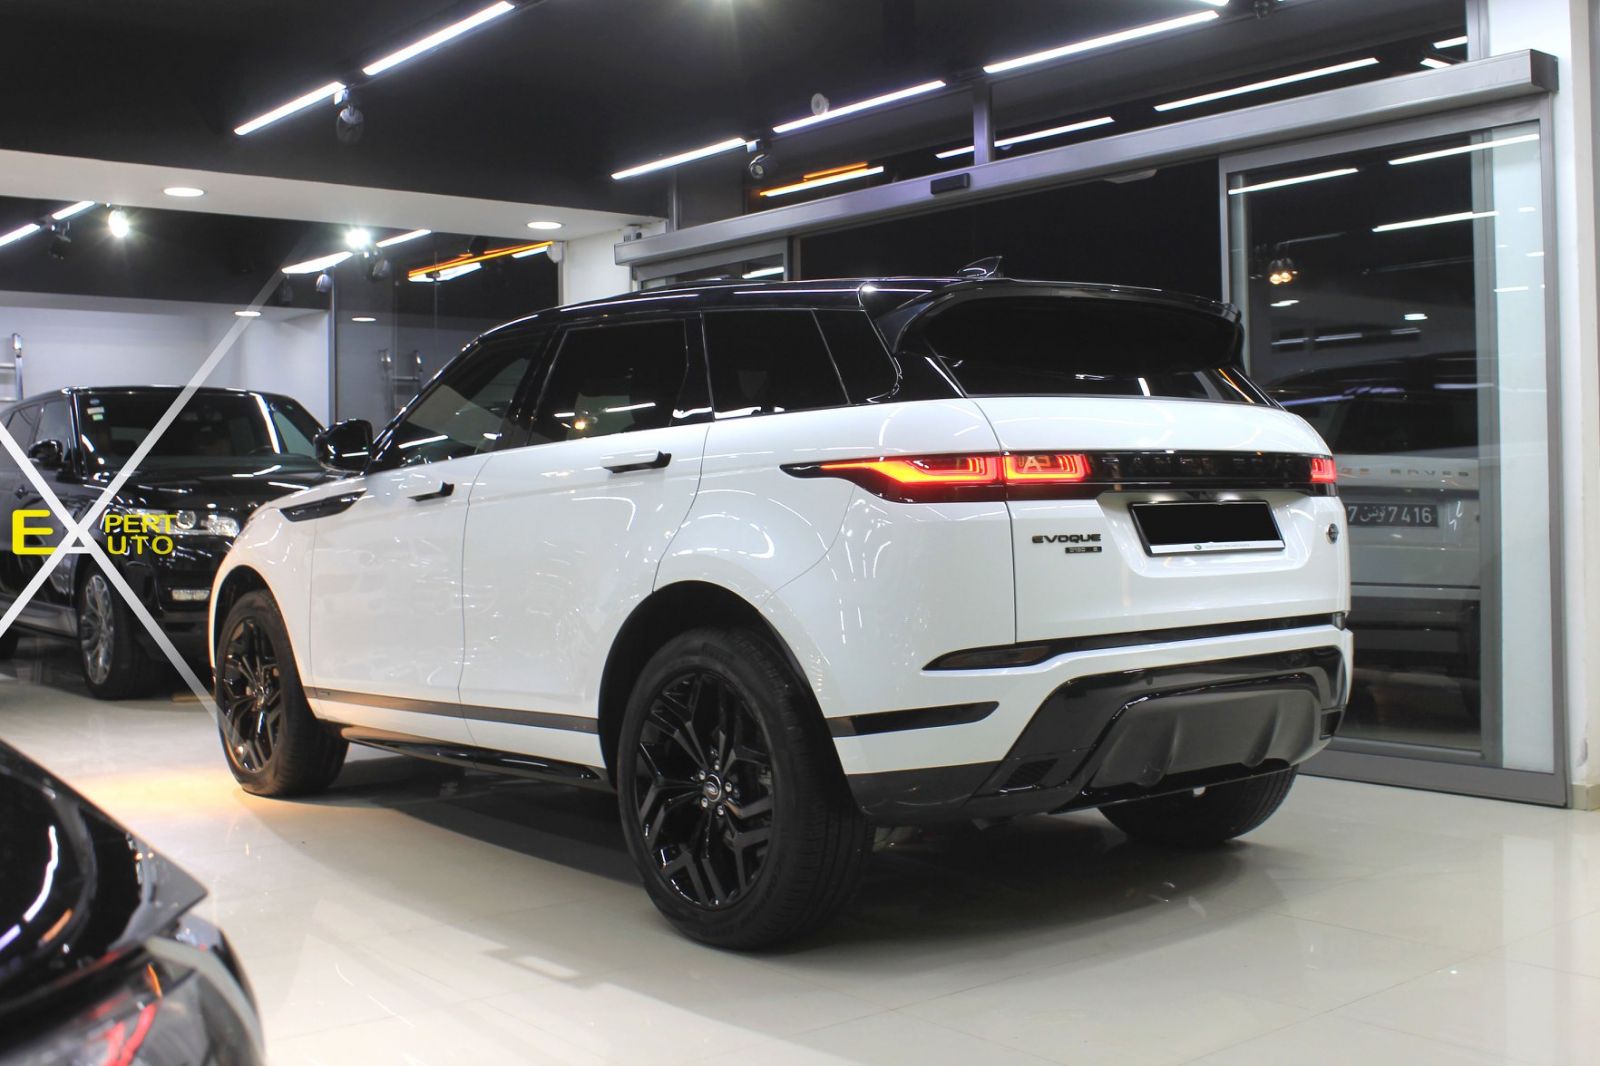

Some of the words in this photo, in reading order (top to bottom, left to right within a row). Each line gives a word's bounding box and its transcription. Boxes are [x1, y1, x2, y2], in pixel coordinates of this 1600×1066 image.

[1360, 505, 1386, 522] تونس
[1388, 506, 1432, 523] 7416
[1032, 533, 1102, 543] EVOQUE
